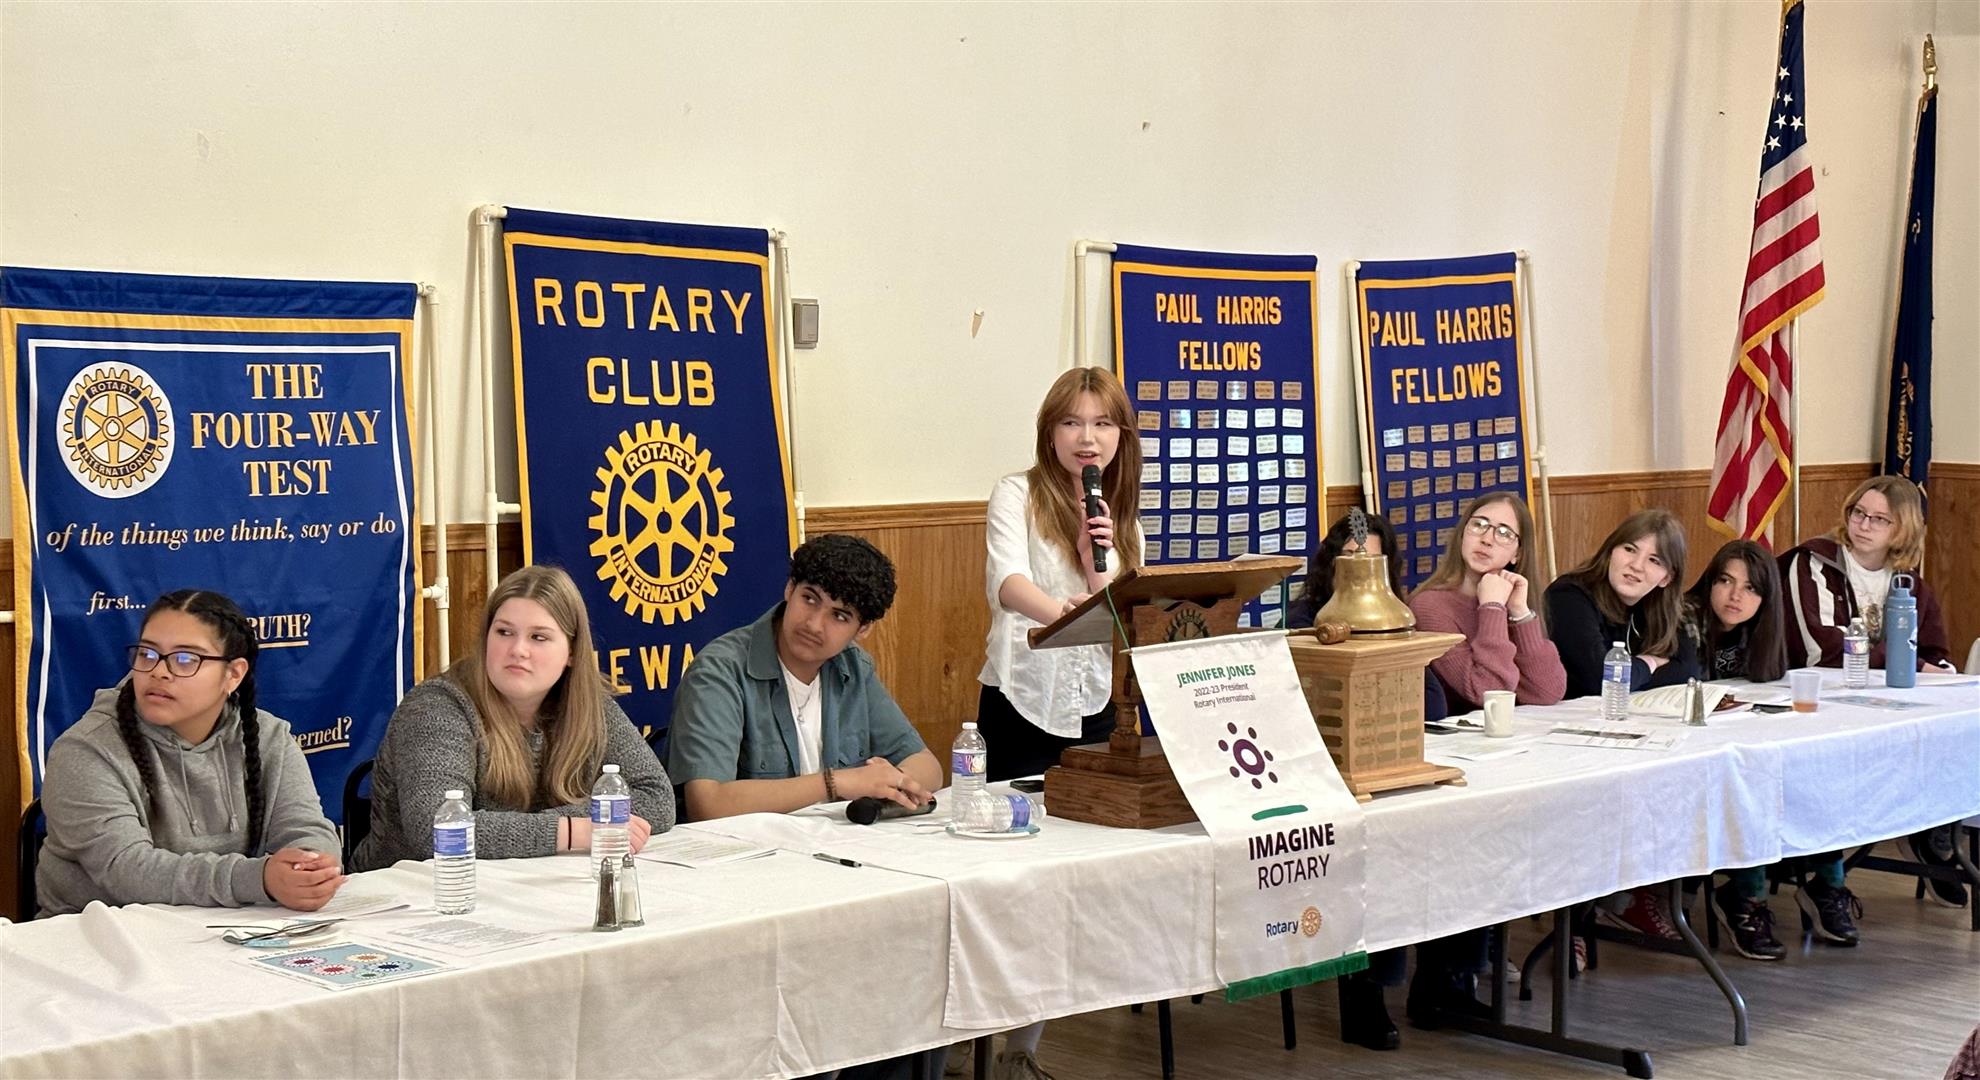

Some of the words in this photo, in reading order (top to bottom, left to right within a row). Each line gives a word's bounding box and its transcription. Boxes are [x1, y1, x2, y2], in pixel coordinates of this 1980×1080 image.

[533, 277, 752, 335] ROTARY
[1155, 292, 1203, 324] PAUL
[1216, 295, 1282, 325] HARRIS
[1369, 310, 1425, 348] PAUL
[1435, 303, 1513, 345] HARRIS
[1178, 340, 1262, 371] FELLOWS
[90, 381, 137, 396] ROTARY
[246, 363, 324, 400] THE
[586, 356, 716, 407] CLUB
[1391, 360, 1502, 405] FELLOWS
[190, 409, 382, 449] FOUR-WAY
[80, 446, 155, 477] INTERNATIONAL
[625, 442, 697, 473] ROTARY
[242, 458, 332, 497] TEST
[46, 523, 77, 553] of
[80, 522, 114, 547] the
[121, 521, 188, 551] things
[193, 526, 225, 544] we
[231, 518, 295, 543] think,
[300, 522, 332, 544] say
[338, 519, 365, 536] or
[370, 512, 397, 534] do
[612, 549, 716, 603] INTERNATIONAL
[86, 591, 147, 616] first...
[246, 613, 312, 641] RUTH?
[1176, 667, 1226, 688] JENNIFER
[1227, 664, 1256, 681] JONES
[1193, 684, 1221, 697] 2022-23
[1221, 682, 1249, 693] President
[1193, 697, 1217, 709] Rotary
[1217, 694, 1256, 704] International
[293, 715, 353, 748] erned?
[1248, 822, 1336, 861] IMAGINE
[1257, 853, 1330, 890] ROTARY
[1266, 920, 1299, 938] Rotary
